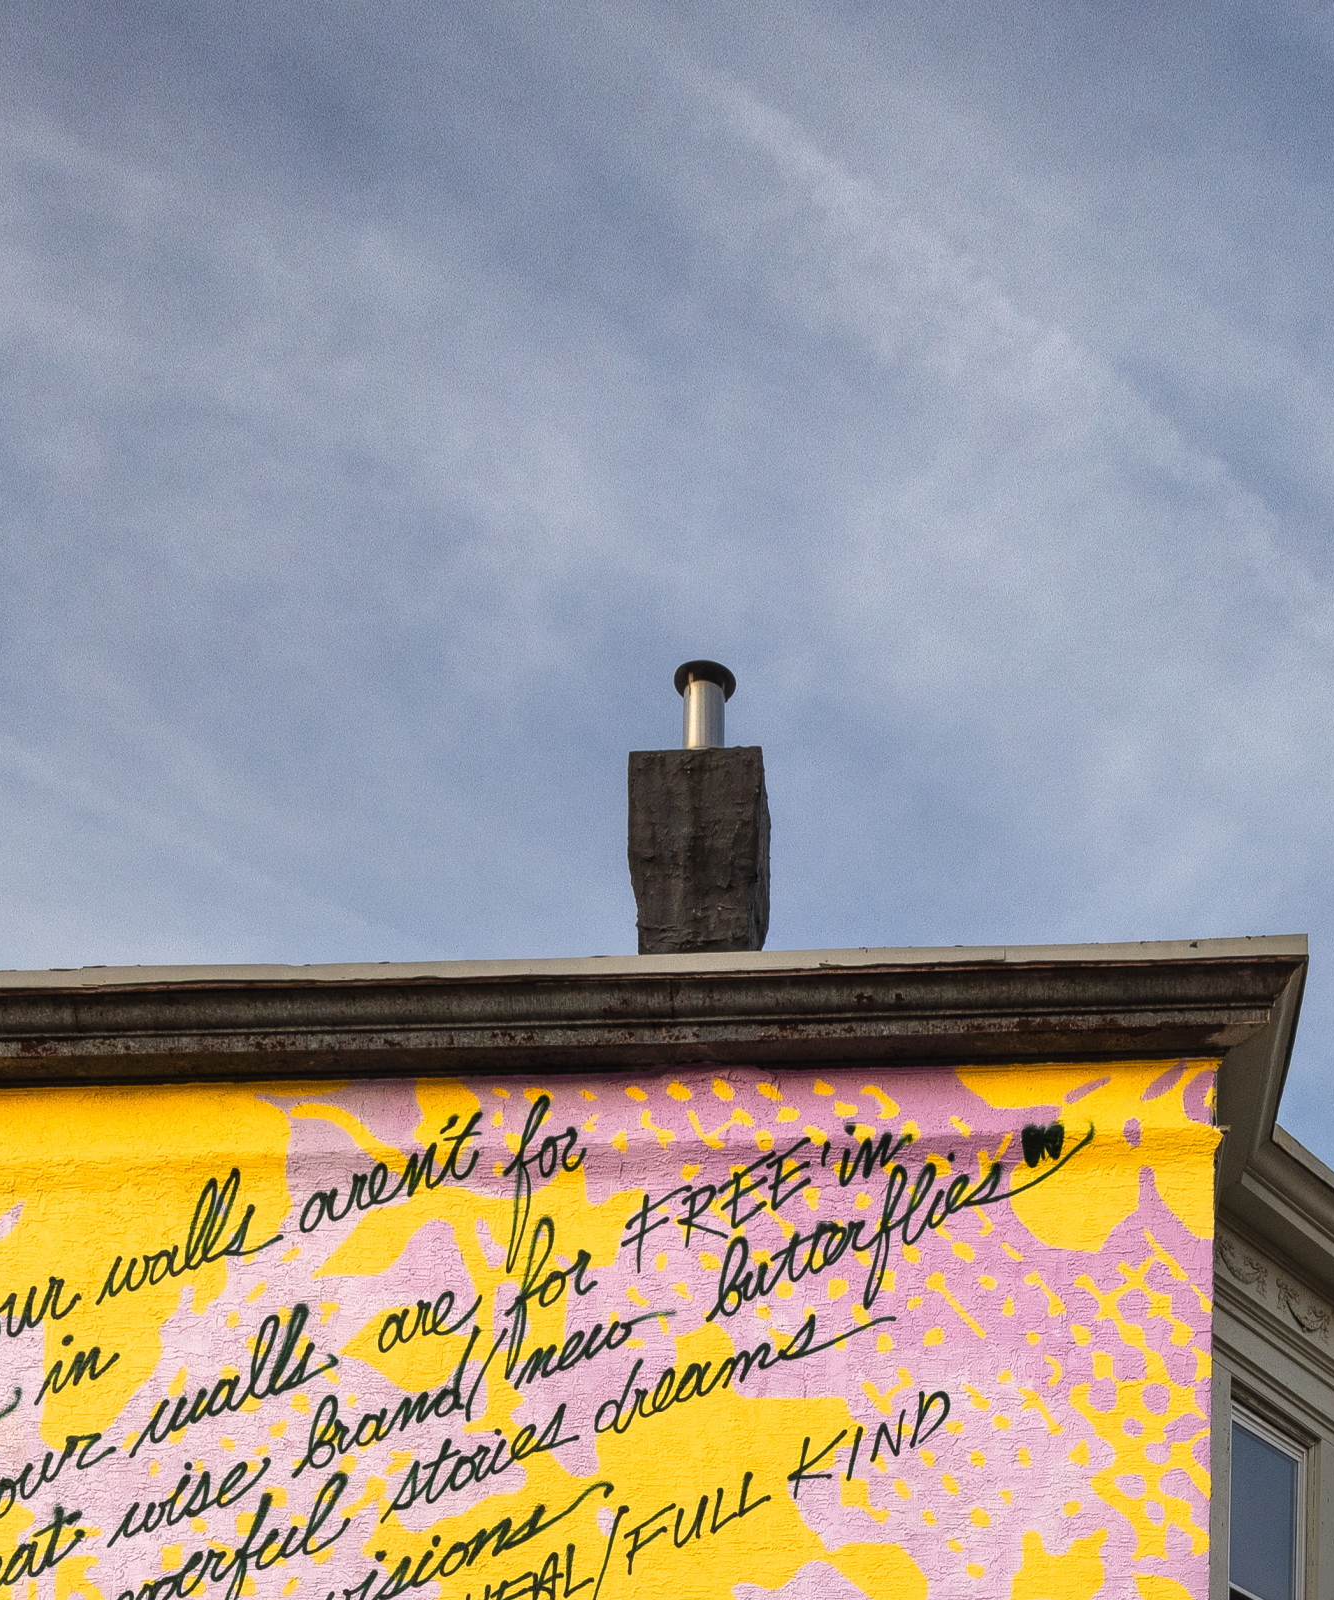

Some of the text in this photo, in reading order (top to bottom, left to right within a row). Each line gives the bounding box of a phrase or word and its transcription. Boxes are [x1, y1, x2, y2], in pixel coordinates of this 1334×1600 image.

[96, 1168, 284, 1306] walls
[502, 1094, 587, 1273] for
[34, 1333, 119, 1405] in
[107, 1456, 271, 1549] wise
[707, 1120, 1096, 1322] butterflies
[129, 1303, 340, 1457] walls
[378, 1290, 484, 1353] are
[504, 1215, 598, 1379] for
[381, 1402, 581, 1521] stories
[594, 1315, 896, 1434] dreams
[788, 1390, 953, 1499] KIND
